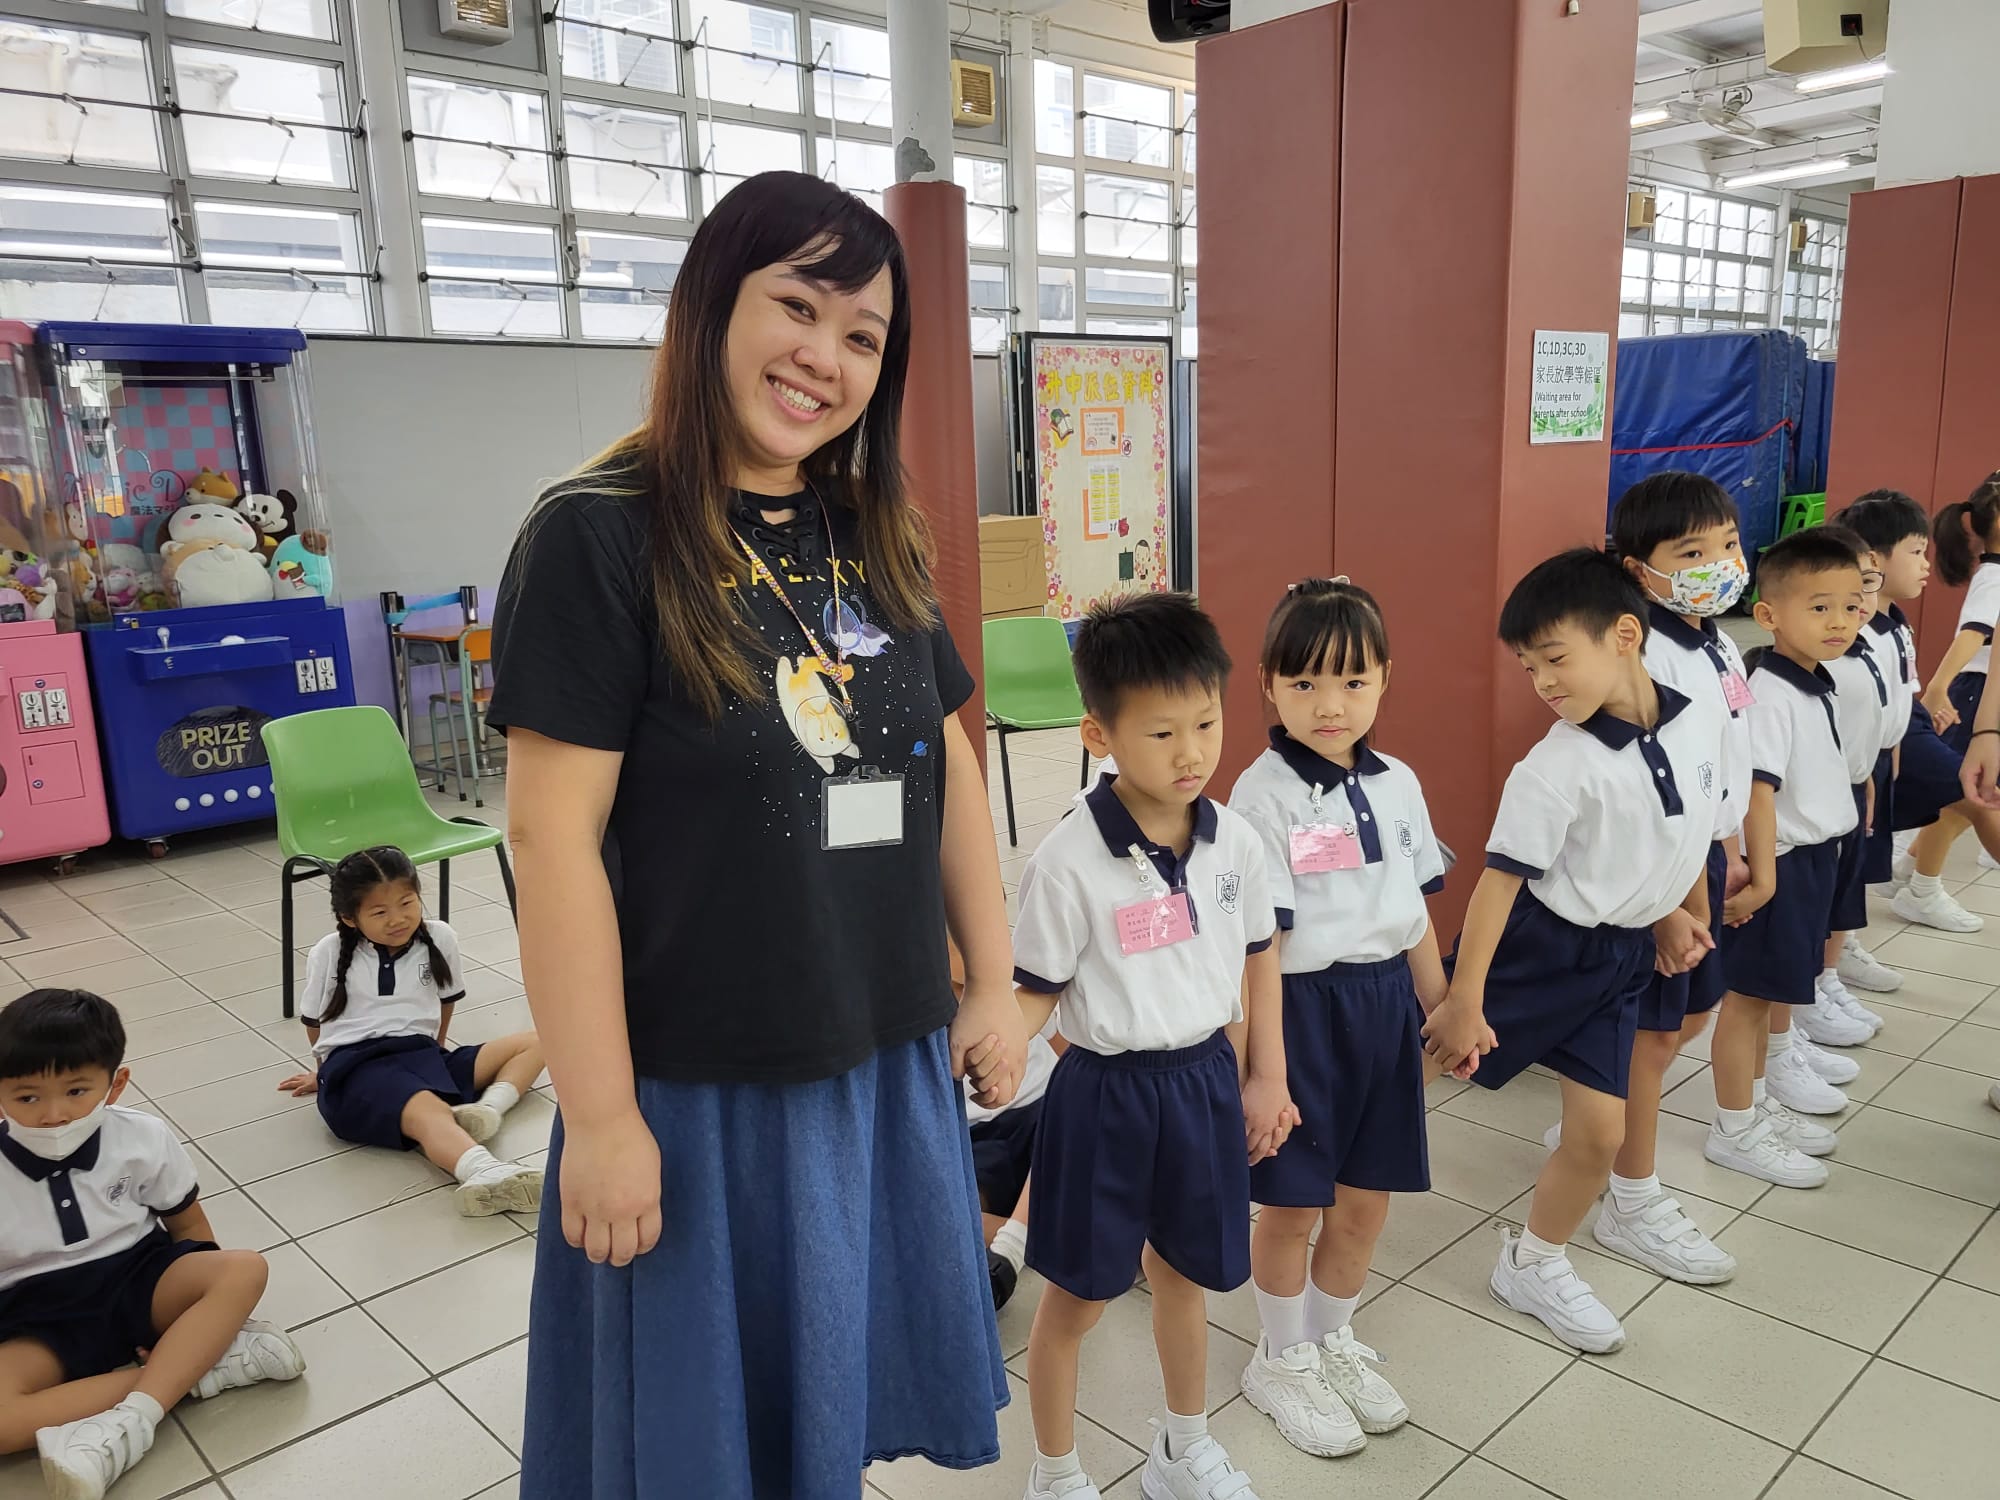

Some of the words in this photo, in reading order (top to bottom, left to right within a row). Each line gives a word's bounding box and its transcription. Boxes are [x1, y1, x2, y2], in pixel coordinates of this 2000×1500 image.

[1537, 341, 1586, 358] 1C,1D,3C,3D
[1536, 365, 1601, 384] 家長放學等候區
[1047, 368, 1154, 405] 升中派位資料
[1559, 394, 1572, 402] area
[1573, 392, 1582, 401] for
[1556, 408, 1570, 418] after
[180, 720, 252, 750] PRIZE
[191, 744, 246, 770] OUT
